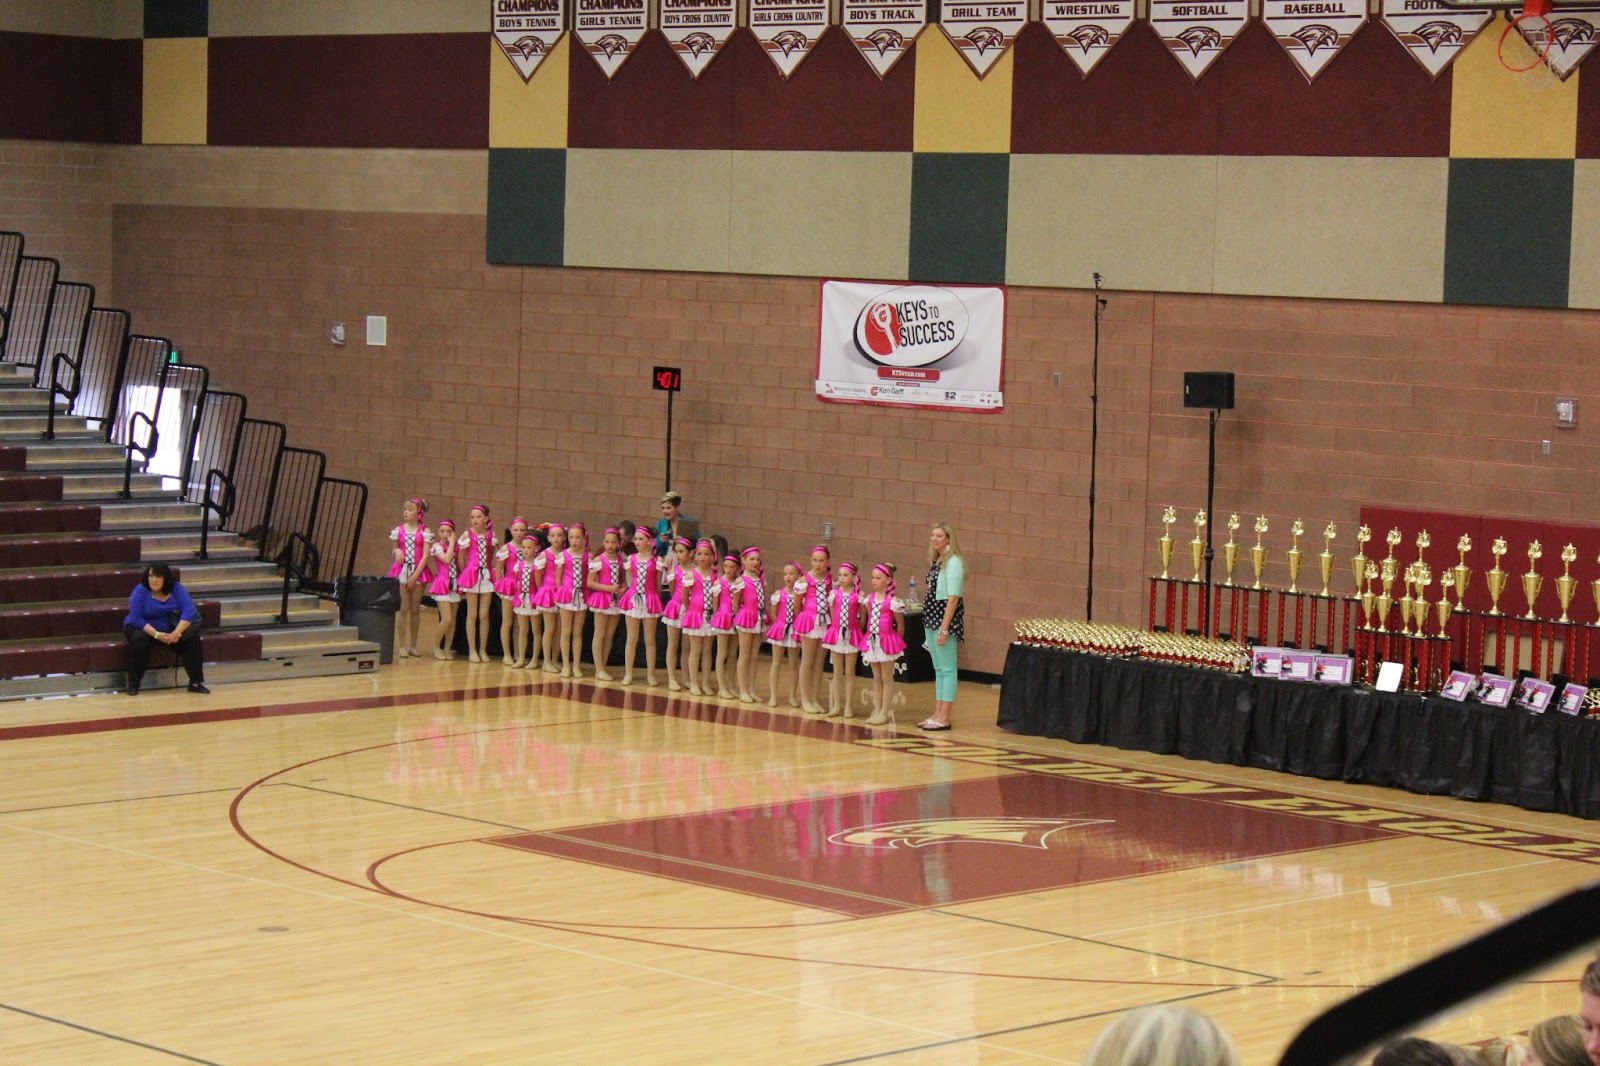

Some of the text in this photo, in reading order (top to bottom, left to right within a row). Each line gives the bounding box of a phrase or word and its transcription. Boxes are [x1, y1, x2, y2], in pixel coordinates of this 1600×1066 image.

[498, 0, 559, 12] CHAMPIONS
[1055, 4, 1120, 15] WRESTLING
[1172, 5, 1228, 16] SOFTBALL
[1283, 3, 1346, 15] BASEBALL
[753, 11, 824, 22] GIRLS CROSS COUNTRY
[850, 9, 915, 20] BOYS TRACK
[951, 7, 1017, 18] DRILL TEAM
[499, 17, 556, 28] BOYS TENNIS
[579, 15, 642, 26] GIRLS TENNIS
[664, 13, 731, 24] BOYS CROSS COUNTRY
[895, 300, 940, 324] KEYS TO
[900, 320, 955, 348] SUCCESS
[1222, 796, 1600, 862] EAGLE
